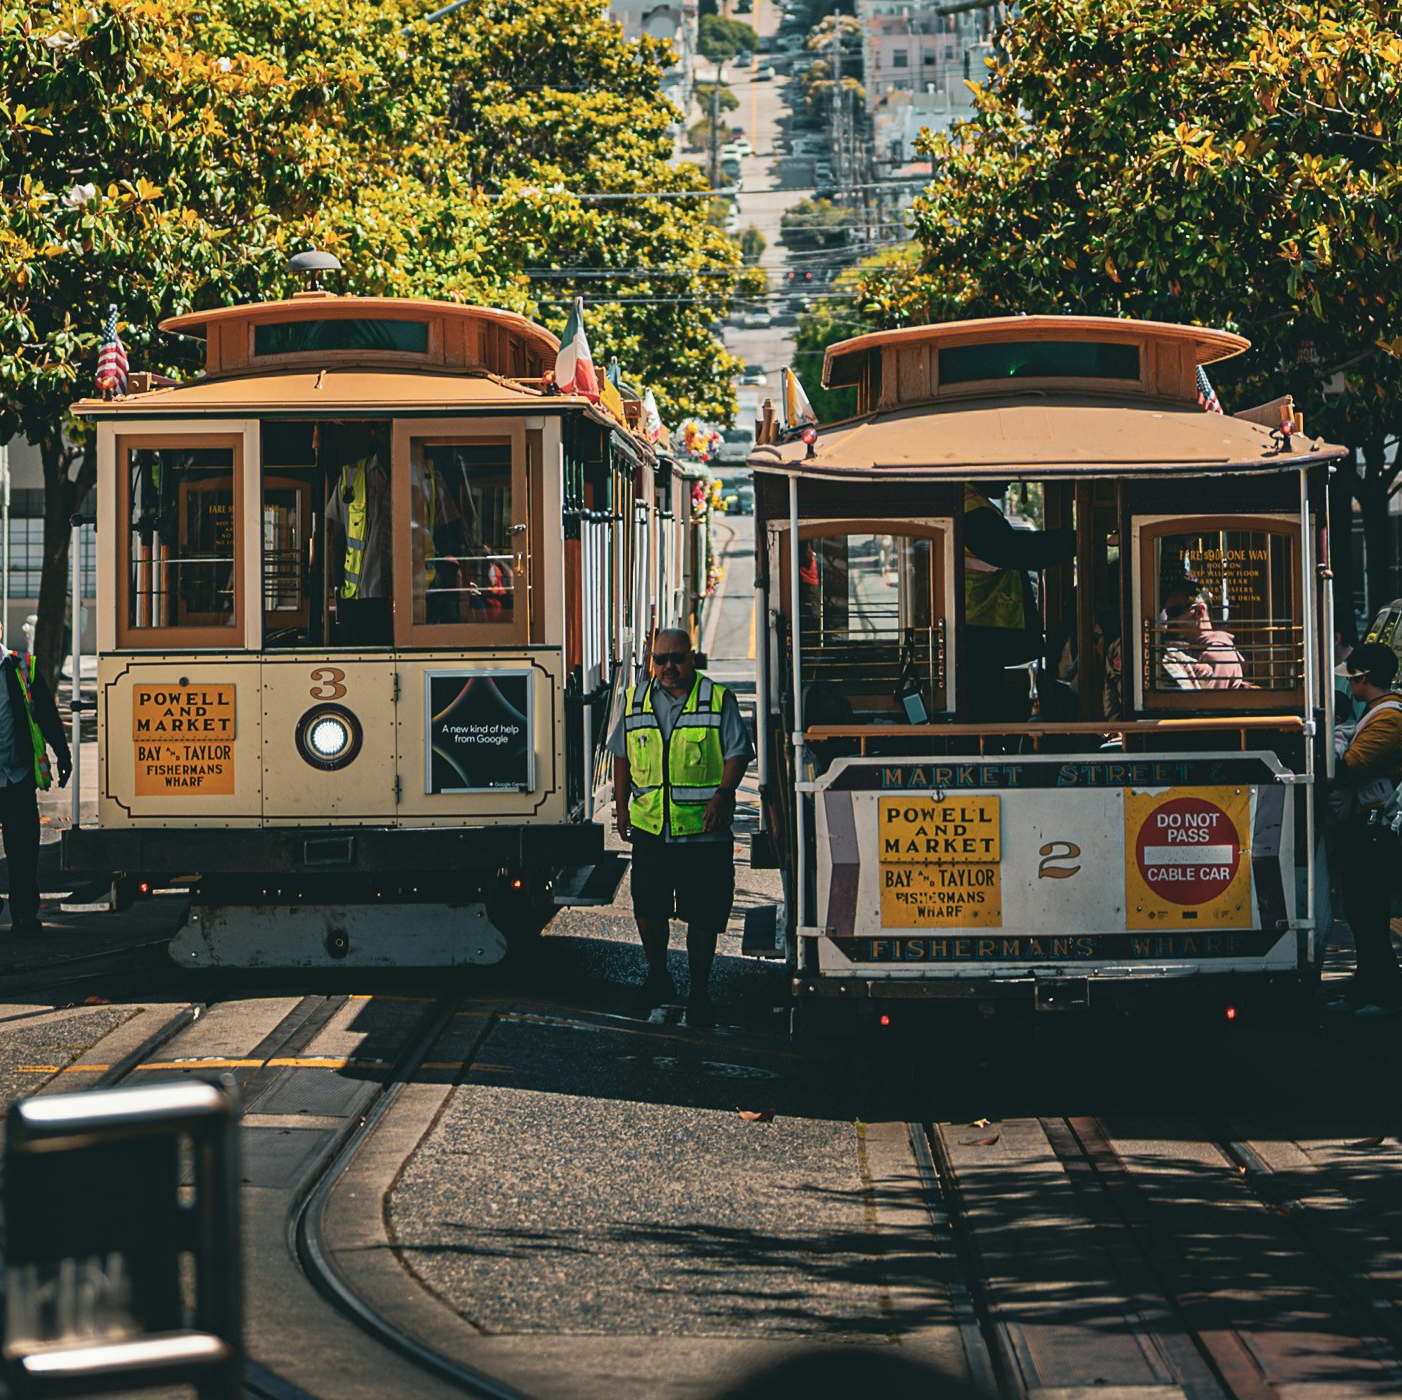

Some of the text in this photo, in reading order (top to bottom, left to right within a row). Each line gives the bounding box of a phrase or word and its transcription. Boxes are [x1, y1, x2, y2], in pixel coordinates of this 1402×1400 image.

[1227, 551, 1246, 561] ONE
[1249, 550, 1269, 561] WAY
[310, 667, 347, 701] 3
[139, 692, 230, 706] POWELL
[163, 707, 207, 717] AND
[137, 718, 231, 732] MARKET
[442, 724, 449, 733] A
[470, 724, 488, 733] kind
[489, 724, 499, 733] of
[500, 724, 519, 735] help
[454, 734, 509, 745] from Google
[138, 746, 161, 761] BAY
[183, 745, 231, 761] TAYLOR
[146, 764, 223, 776] FISHERMANS
[881, 766, 1023, 789] MARKET
[1057, 762, 1199, 787] STREET
[164, 776, 204, 788] WHARF
[887, 807, 993, 823] POWELL
[1157, 813, 1220, 828] DO NOT
[915, 825, 967, 837] AND
[1167, 828, 1210, 843] PASS
[884, 838, 995, 854] MARKET
[1038, 841, 1082, 880] 2
[885, 870, 912, 888] BAY
[939, 869, 995, 887] TAYLOR
[1147, 867, 1230, 882] CABLE CAR
[917, 905, 963, 918] WHARF
[868, 933, 1247, 961] FISHERMANS WHARF
